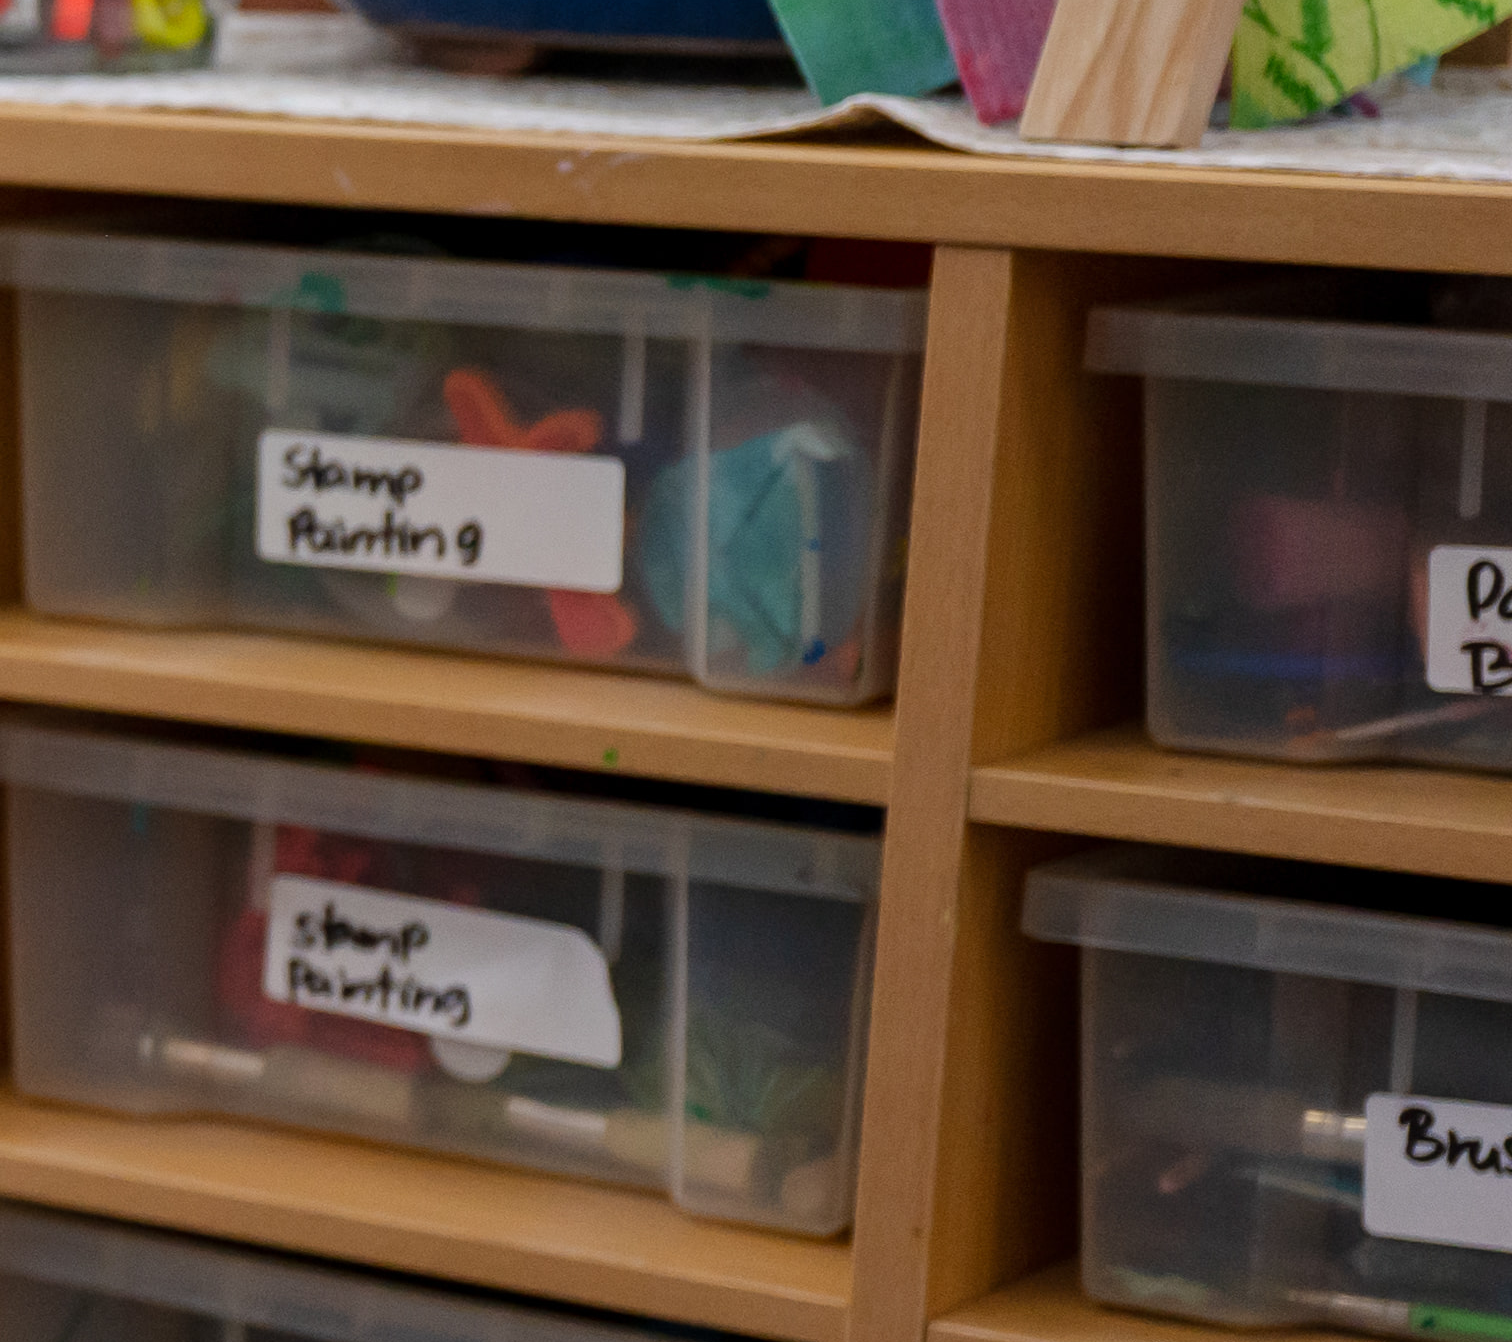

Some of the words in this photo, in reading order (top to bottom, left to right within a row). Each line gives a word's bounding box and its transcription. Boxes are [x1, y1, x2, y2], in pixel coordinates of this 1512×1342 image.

[281, 441, 425, 507] Stamp
[287, 507, 484, 567] Painting
[286, 958, 474, 1028] Painting
